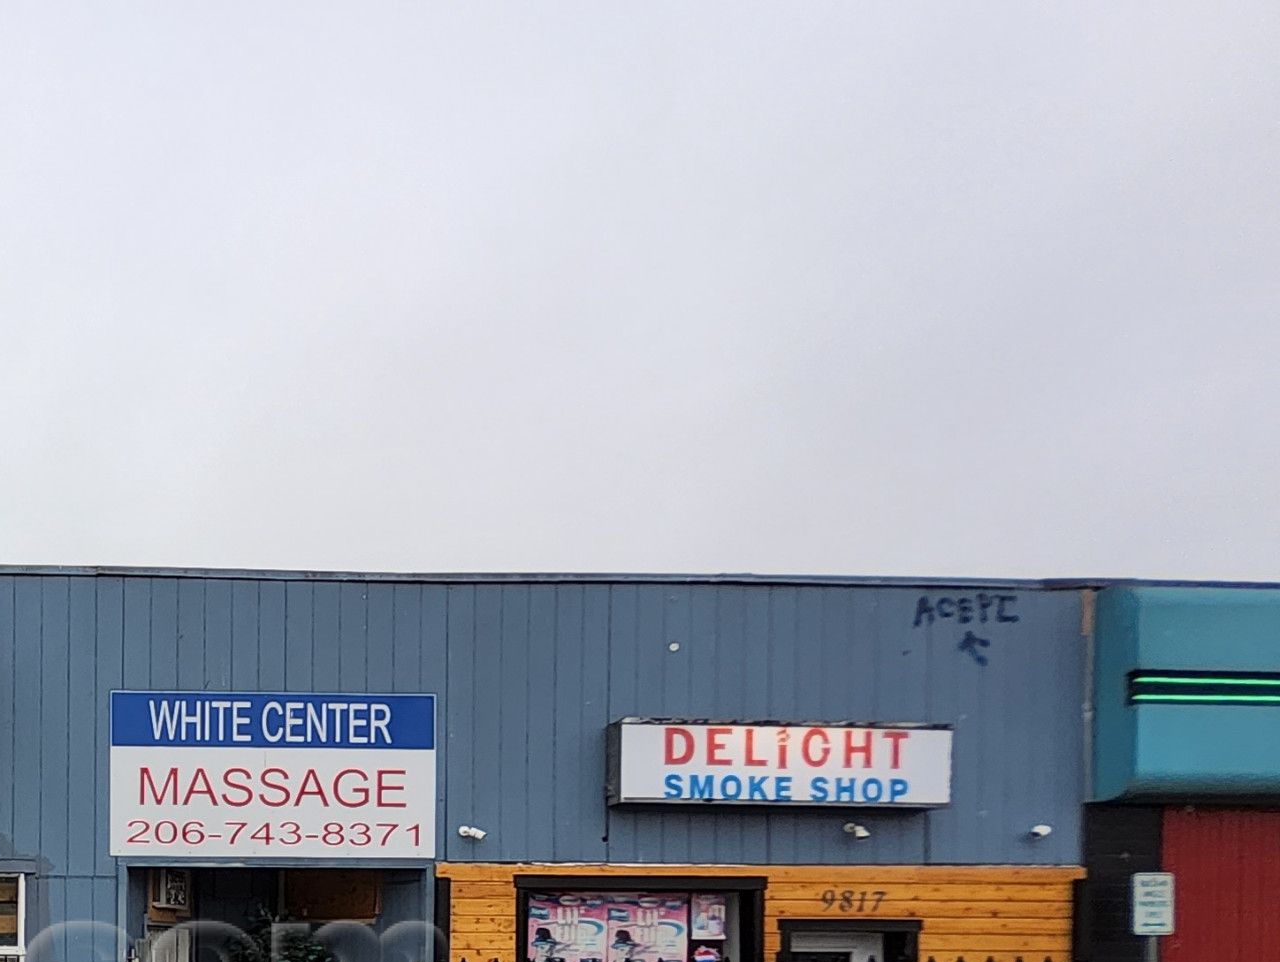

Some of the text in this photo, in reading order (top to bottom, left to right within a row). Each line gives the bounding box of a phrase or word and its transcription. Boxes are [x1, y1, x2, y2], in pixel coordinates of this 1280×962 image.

[149, 699, 393, 744] WHITE CENTER
[138, 767, 408, 809] MASSAGE
[663, 774, 909, 803] SMOKE SHOP
[126, 820, 420, 847] 206-743-8371
[821, 889, 888, 912] 9817
